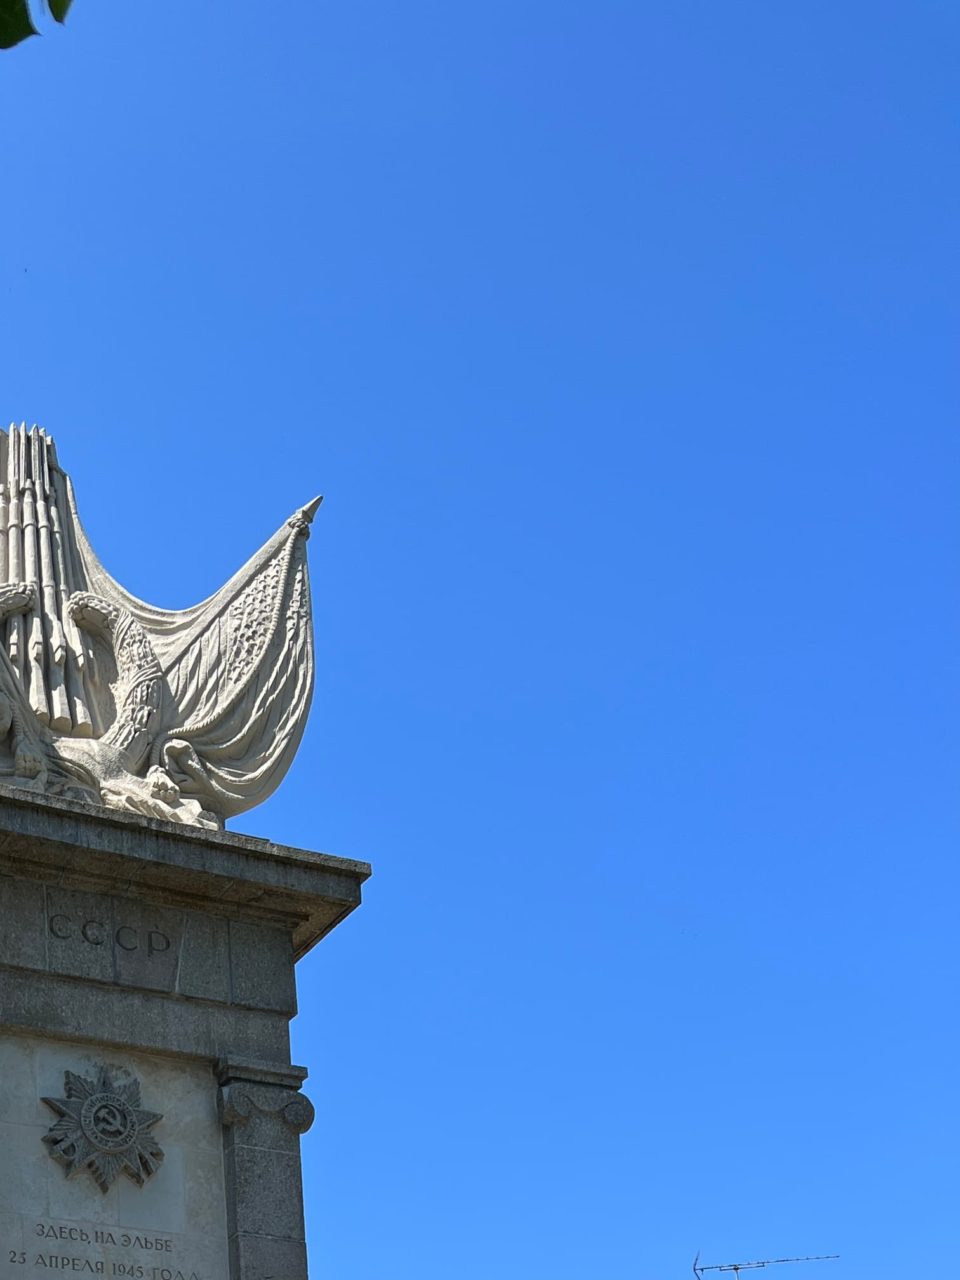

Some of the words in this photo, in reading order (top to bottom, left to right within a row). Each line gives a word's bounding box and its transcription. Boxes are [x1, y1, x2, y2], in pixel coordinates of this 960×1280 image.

[48, 913, 171, 955] СССР
[94, 1230, 117, 1246] НА
[120, 1234, 173, 1252] ЭЛЬБЕ
[8, 1250, 27, 1265] 25
[34, 1253, 105, 1274] АПРЕЛЯ
[112, 1262, 144, 1279] 1945
